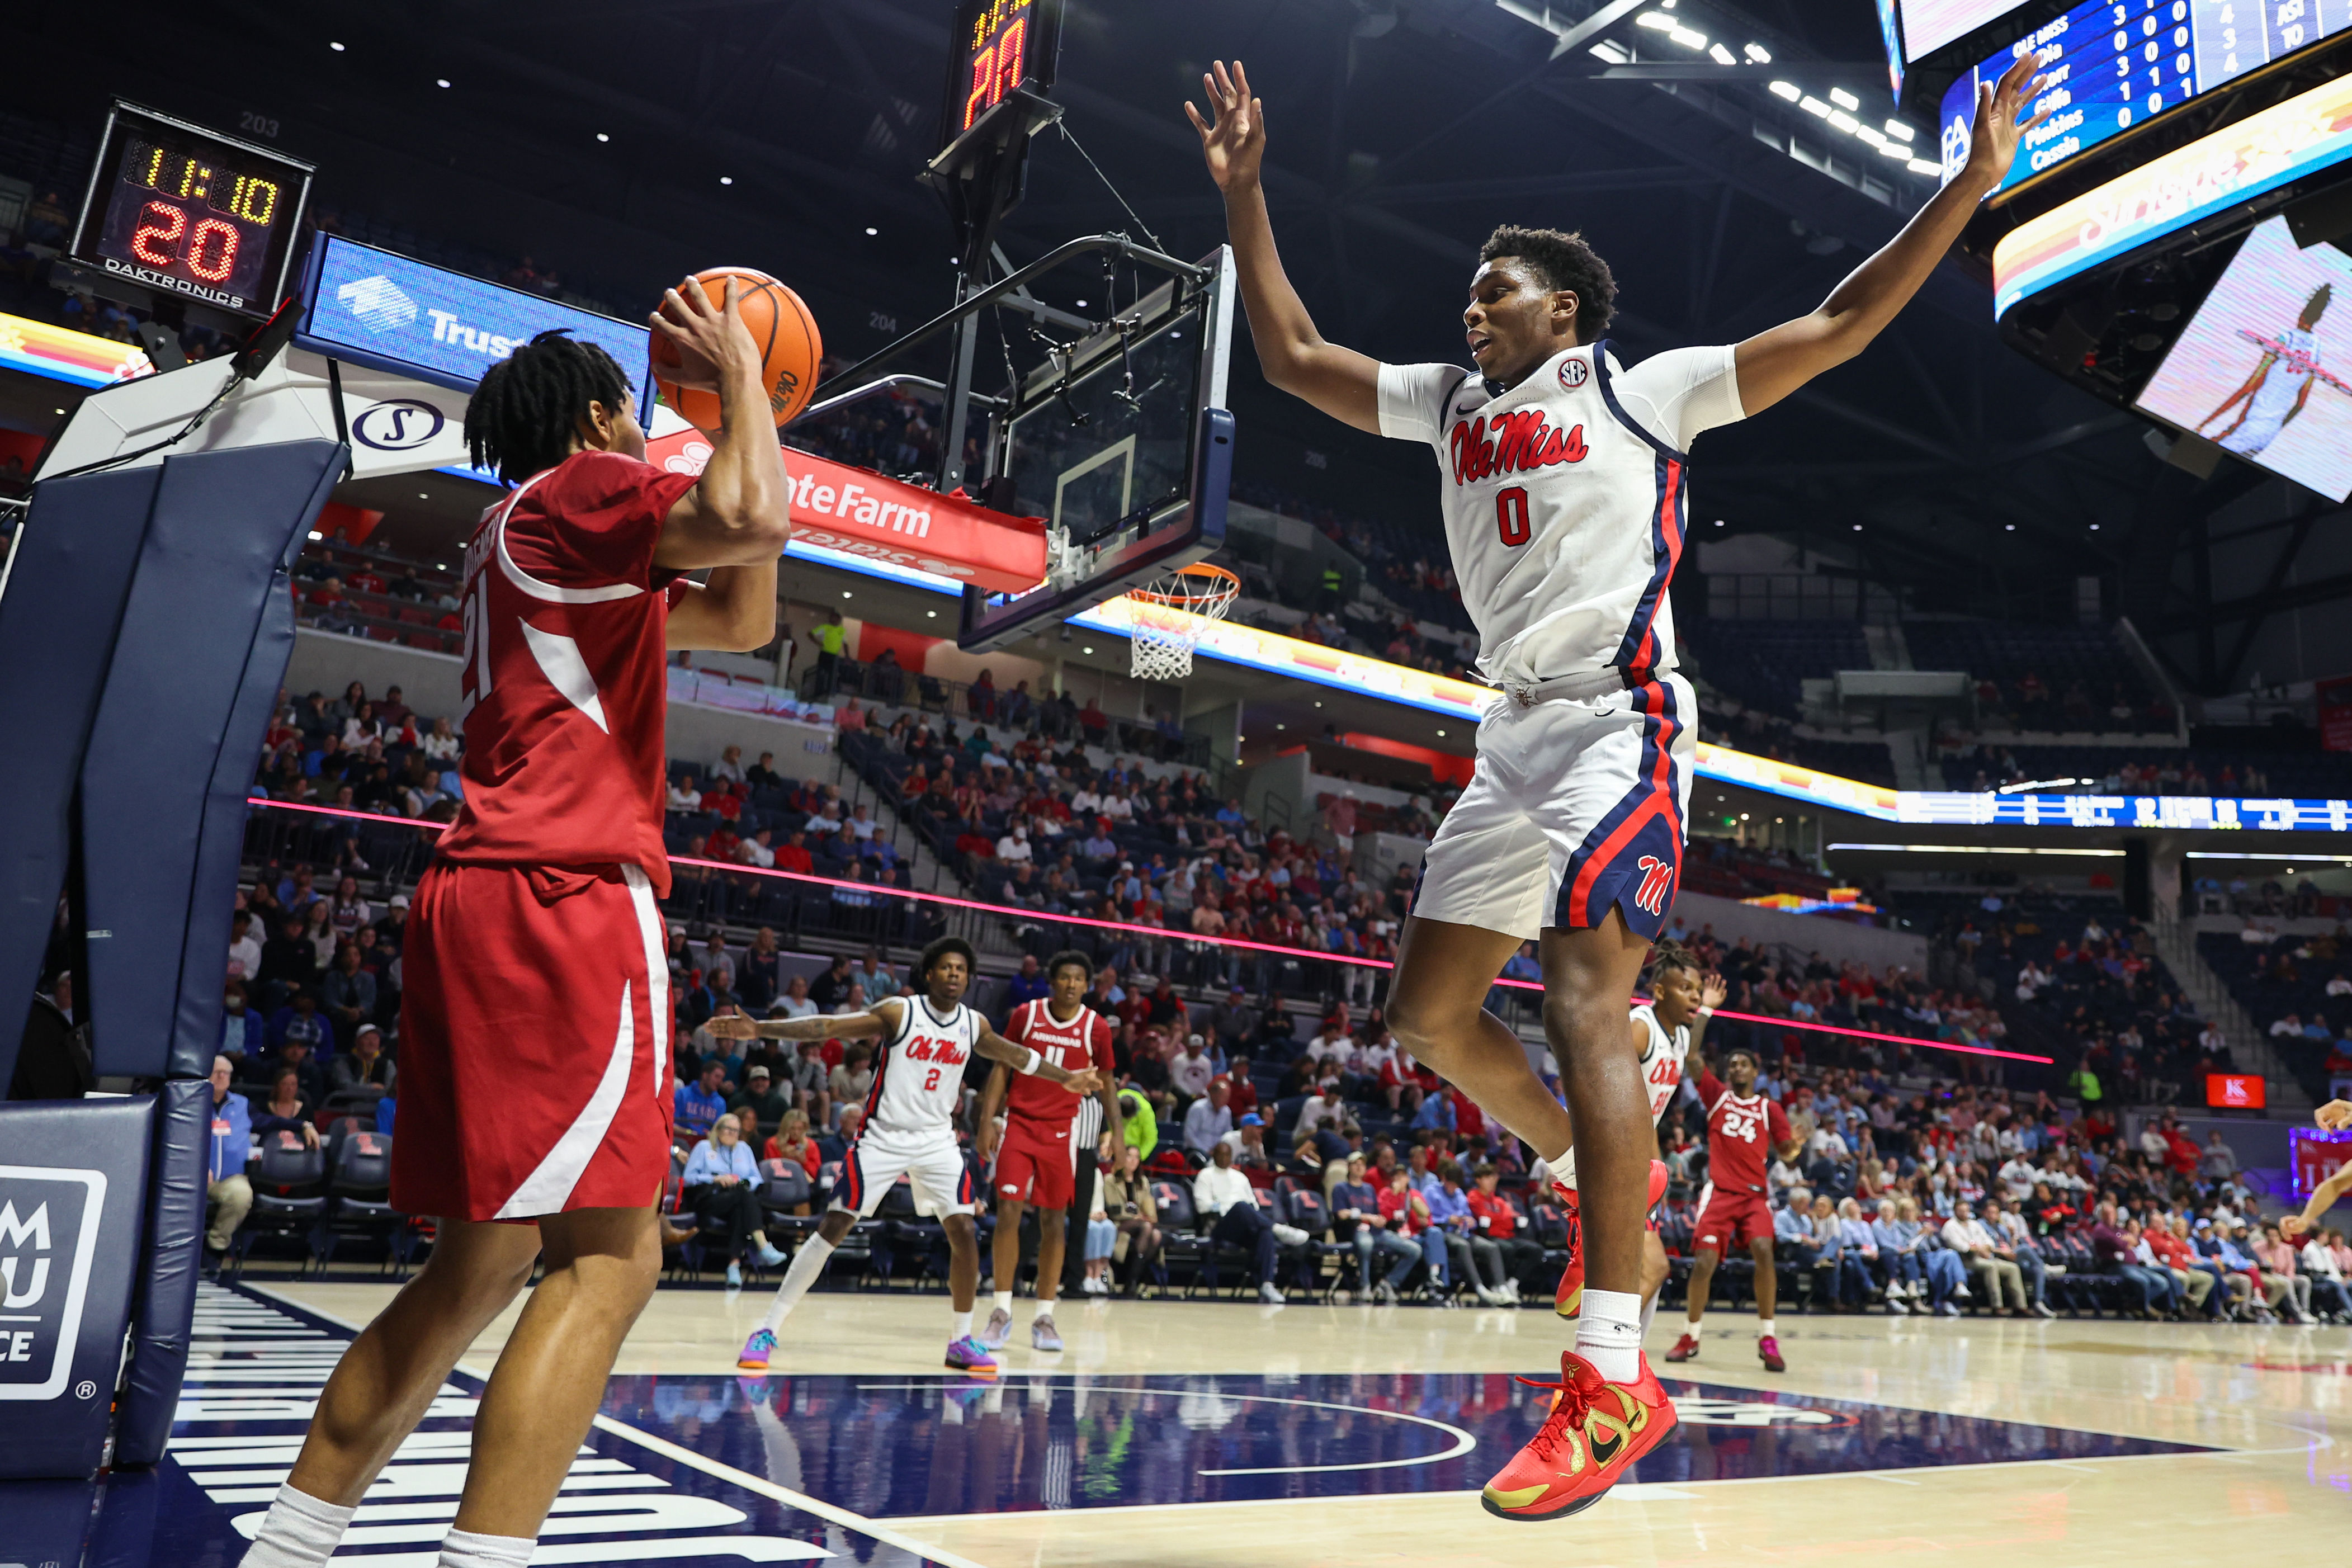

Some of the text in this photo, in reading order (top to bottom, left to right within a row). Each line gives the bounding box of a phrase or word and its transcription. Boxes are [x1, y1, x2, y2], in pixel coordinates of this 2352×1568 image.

[2113, 5, 2127, 26] 3
[2219, 3, 2235, 24] 4
[2013, 15, 2069, 61] OLE MISS
[2114, 30, 2128, 51] 0
[2142, 15, 2157, 36] 0
[2222, 27, 2237, 49] 3
[2281, 23, 2304, 49] TO
[2117, 56, 2129, 77] 3
[2145, 41, 2159, 63] 0
[2174, 26, 2189, 48] 0
[2223, 52, 2238, 73] 4
[2025, 53, 2190, 151] Pinkins 1 1 0
[240, 112, 279, 138] 203
[2030, 77, 2192, 171] Cassia 0 0 1
[146, 148, 278, 225] 11:10
[133, 202, 240, 282] 20
[105, 258, 244, 309] DAKTRONICS
[428, 308, 525, 358] Trus
[870, 311, 896, 333] 204
[1560, 360, 1586, 386] SEC
[1451, 409, 1589, 486] Ole Miss
[1496, 486, 1532, 547] 0
[924, 1068, 941, 1092] 2
[1721, 1112, 1757, 1144] 24
